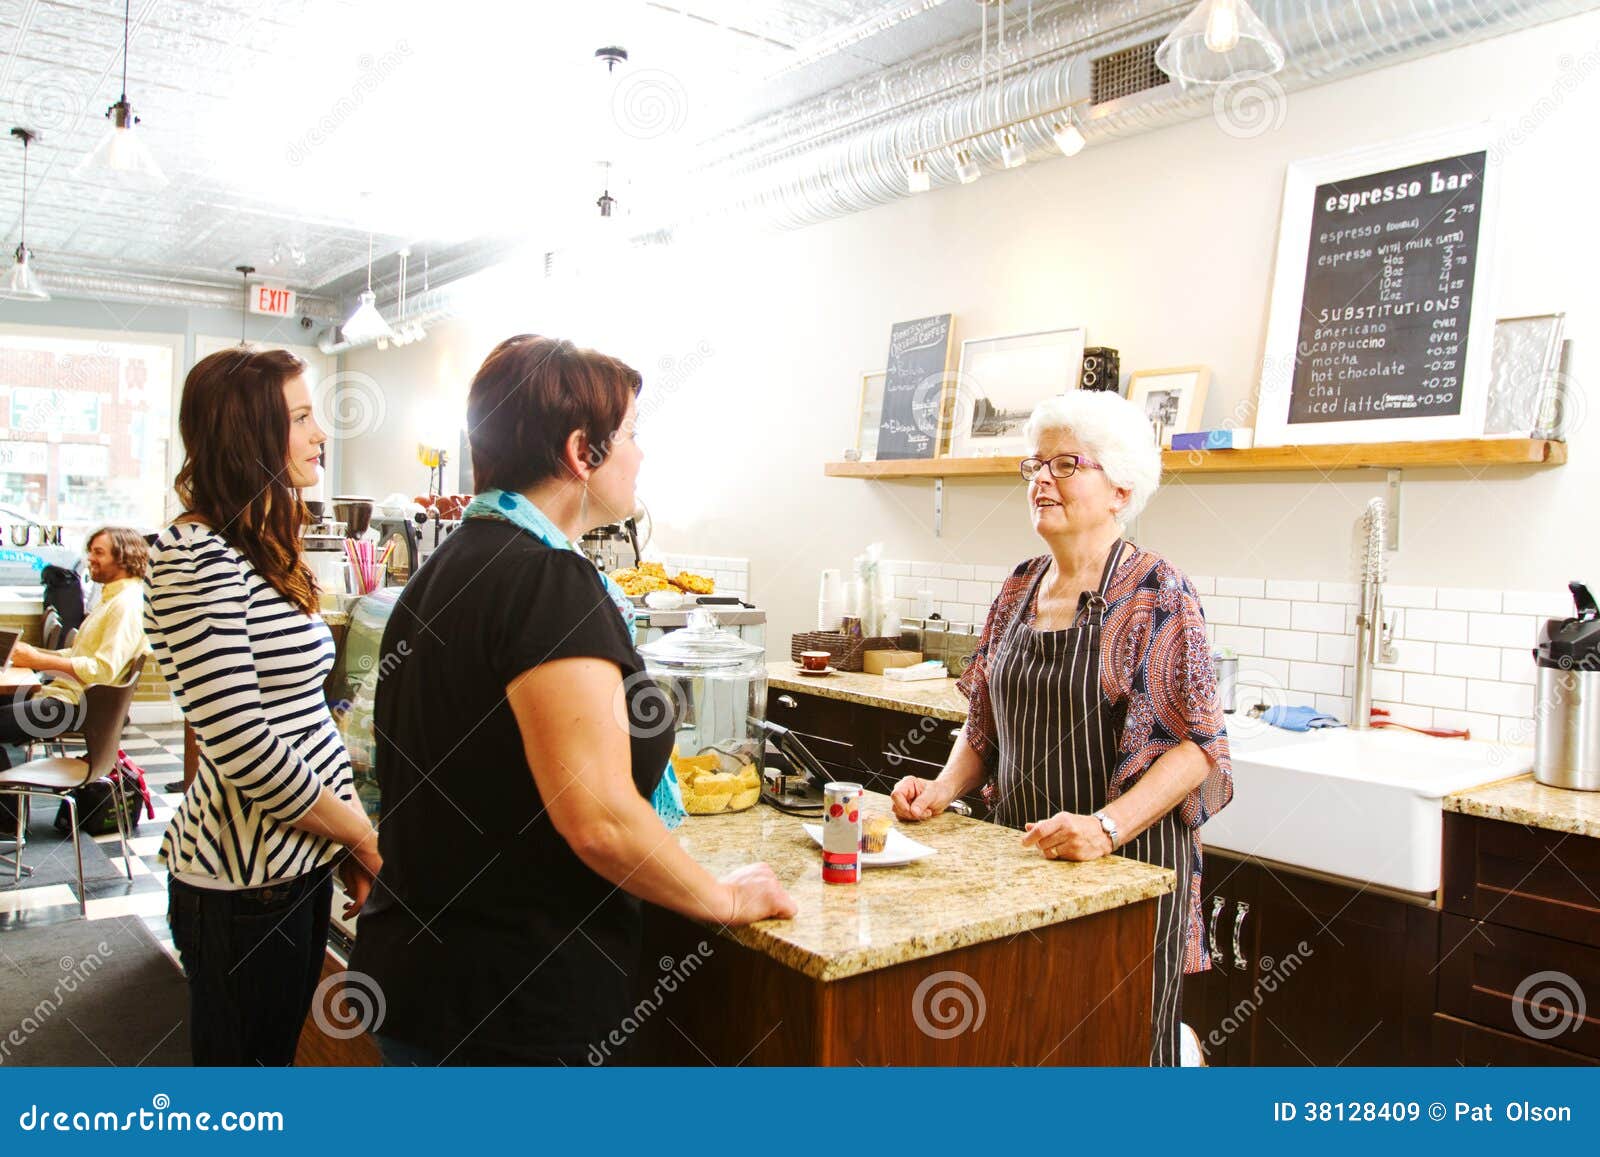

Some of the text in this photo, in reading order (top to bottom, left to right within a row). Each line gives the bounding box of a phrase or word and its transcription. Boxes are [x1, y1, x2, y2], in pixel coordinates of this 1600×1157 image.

[1325, 170, 1473, 213] espresso bar
[1320, 224, 1381, 244] espresso
[1318, 249, 1372, 267] espresso
[259, 287, 291, 313] EXIT
[1318, 296, 1460, 324] SUBSTITUTIONS
[1314, 318, 1457, 341] americano even
[1312, 331, 1458, 354] cappuccino even
[1312, 353, 1359, 367] mocha
[1311, 366, 1333, 383] hot
[1338, 361, 1406, 380] chocolate
[1308, 383, 1342, 398] chai
[1308, 397, 1338, 414] iced
[1343, 397, 1381, 414] latte
[0, 524, 64, 547] UM
